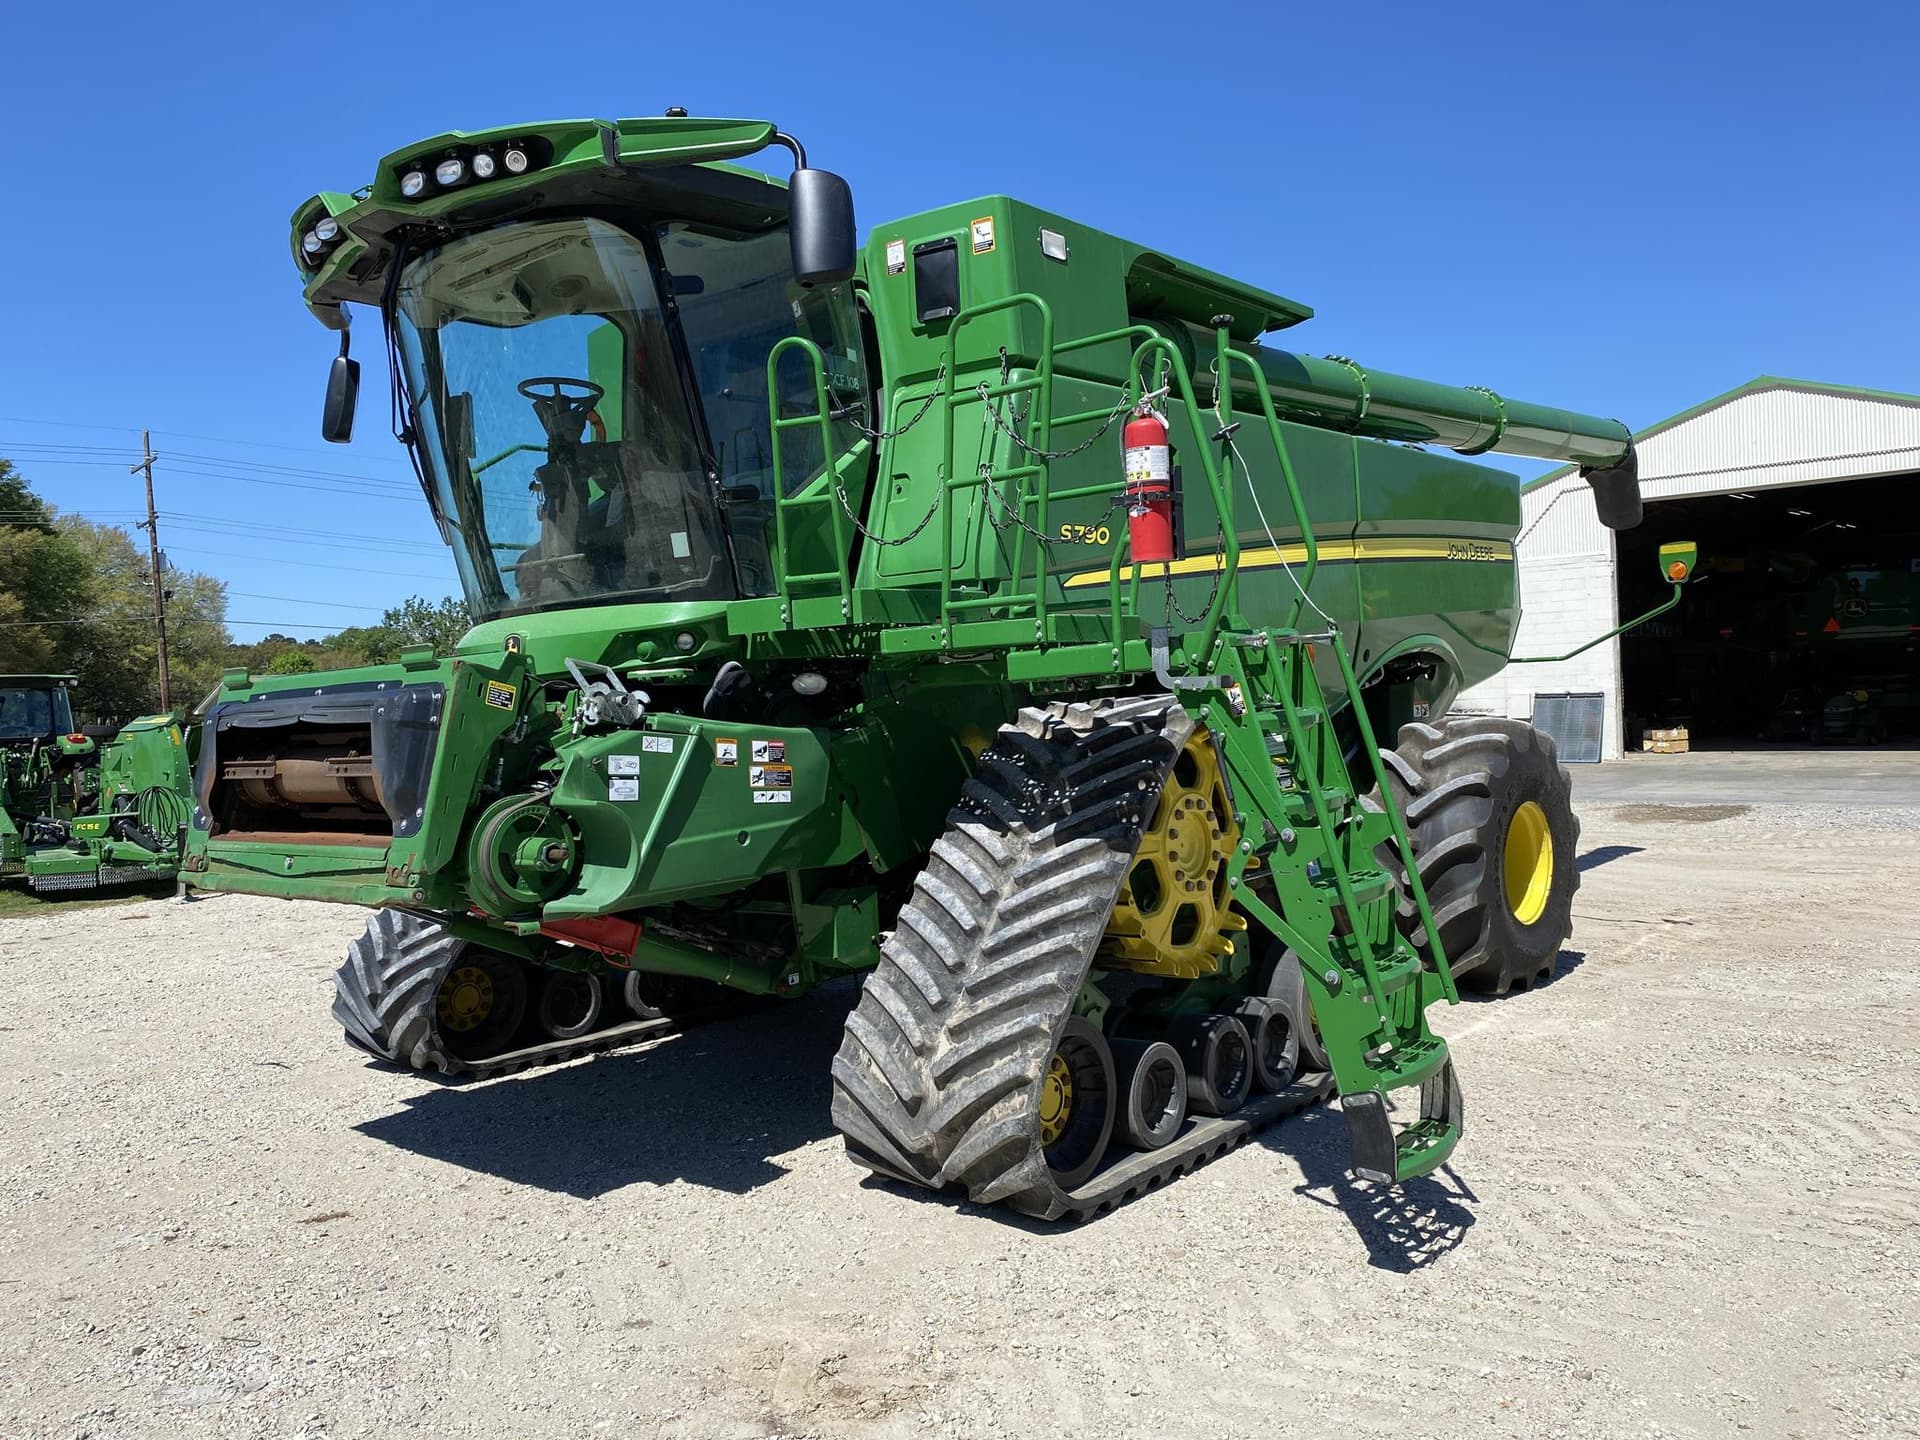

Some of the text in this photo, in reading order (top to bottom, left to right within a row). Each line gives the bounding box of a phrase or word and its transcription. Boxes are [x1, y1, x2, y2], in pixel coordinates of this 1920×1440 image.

[1060, 524, 1110, 545] S790
[1448, 542, 1494, 559] JOHN DEERE
